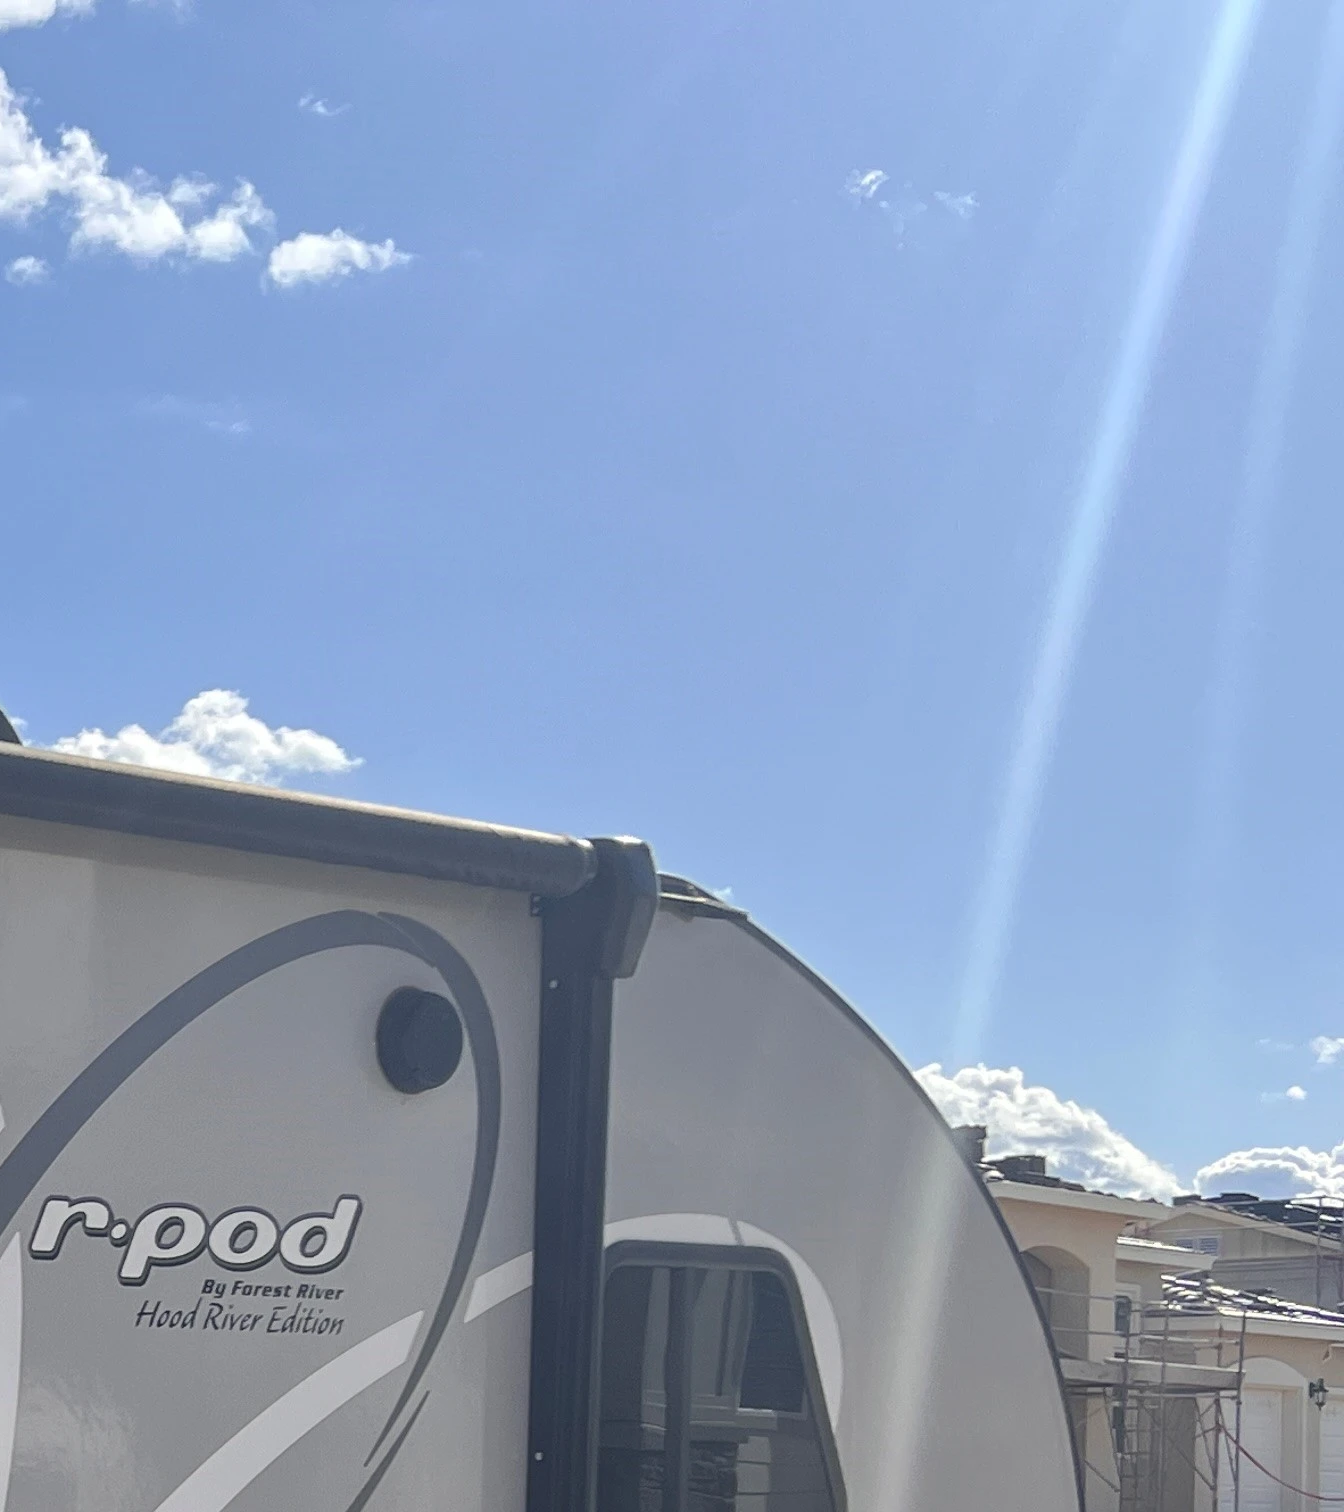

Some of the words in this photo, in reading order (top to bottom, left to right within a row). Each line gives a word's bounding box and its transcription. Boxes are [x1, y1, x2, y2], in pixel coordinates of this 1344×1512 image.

[201, 1279, 226, 1298] By
[231, 1280, 292, 1298] Forest
[296, 1284, 345, 1300] River
[135, 1297, 203, 1328] Hood
[202, 1302, 263, 1331] River
[266, 1302, 344, 1336] Edition
